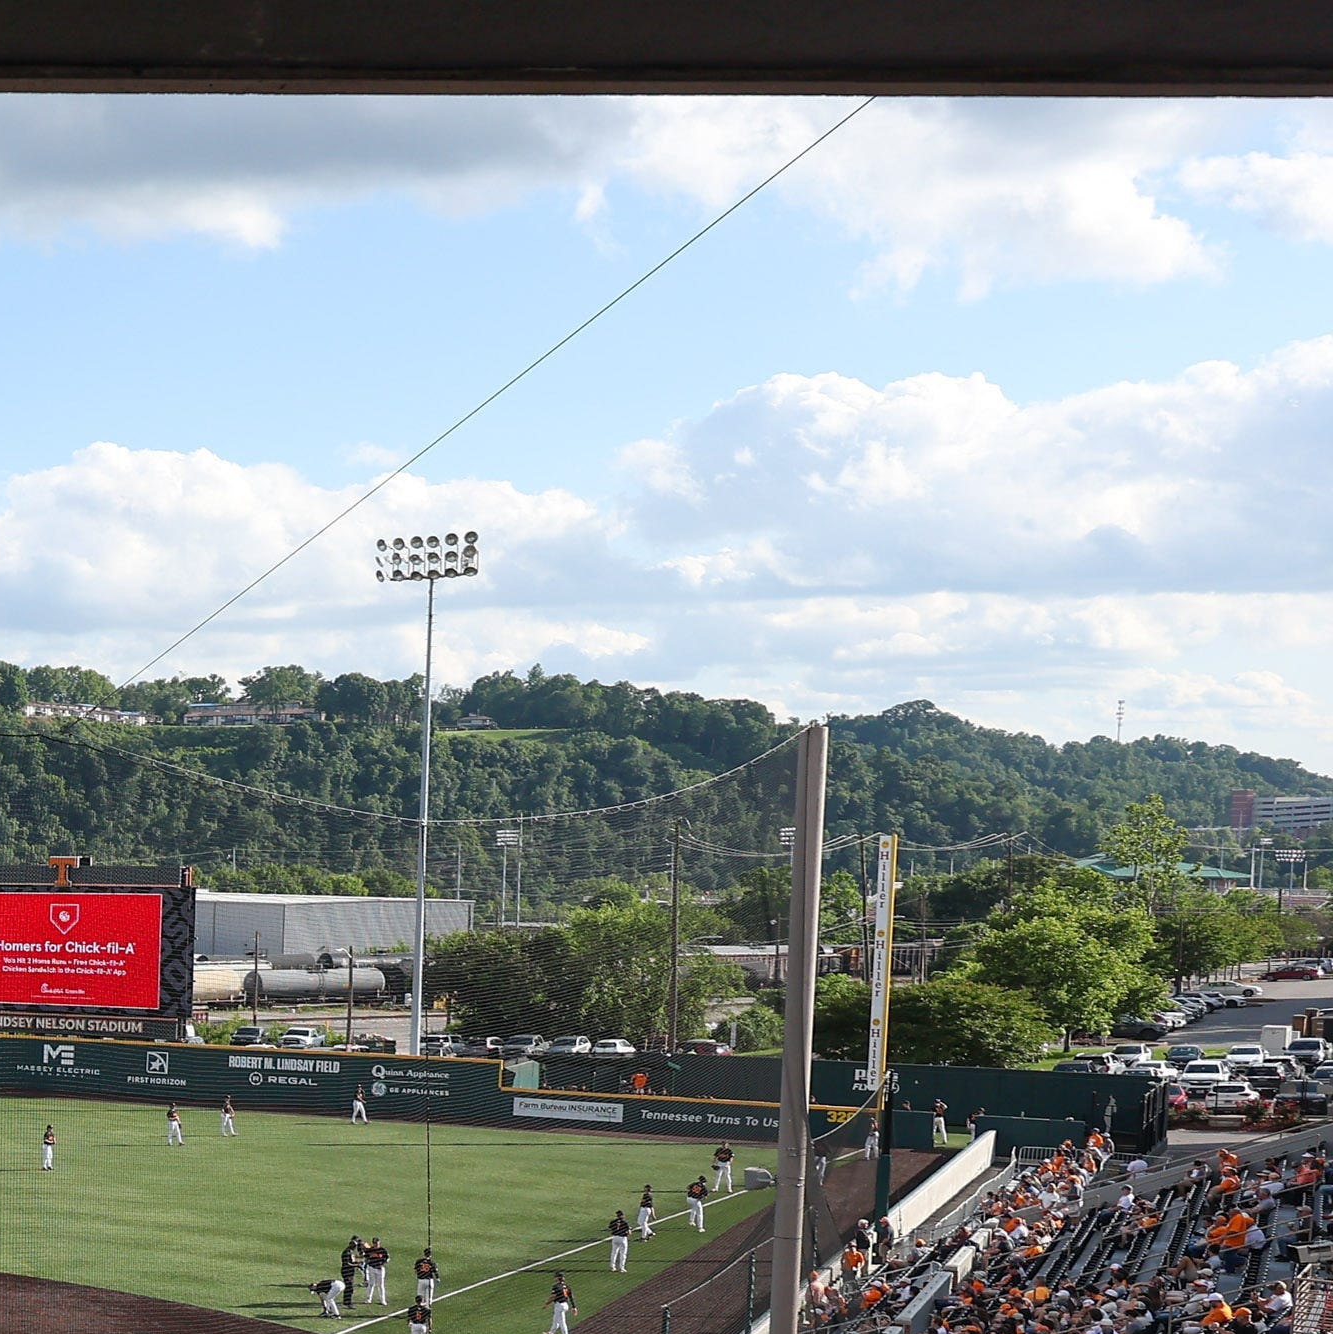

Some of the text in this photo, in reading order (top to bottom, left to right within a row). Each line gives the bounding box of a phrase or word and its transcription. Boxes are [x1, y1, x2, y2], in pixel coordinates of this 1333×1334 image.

[879, 851, 890, 908] Hiller
[44, 940, 63, 953] for
[875, 940, 886, 997] Hiller
[36, 1018, 84, 1031] NELSON
[87, 1020, 143, 1034] STADIUM
[228, 1055, 341, 1074] ROBERT M. LINDSAY FIELD
[870, 1028, 881, 1085] Hiller
[16, 1064, 101, 1076] MASSEY ELECTRIC
[371, 1064, 451, 1080] Quinn Appliance
[127, 1076, 187, 1087] FIRST HORIZON
[268, 1075, 318, 1086] REGAL
[401, 1087, 450, 1097] APPLIANCES
[518, 1101, 618, 1115] Farm Bureau INSURANCE
[640, 1109, 780, 1129] Tennessee Turns To Us
